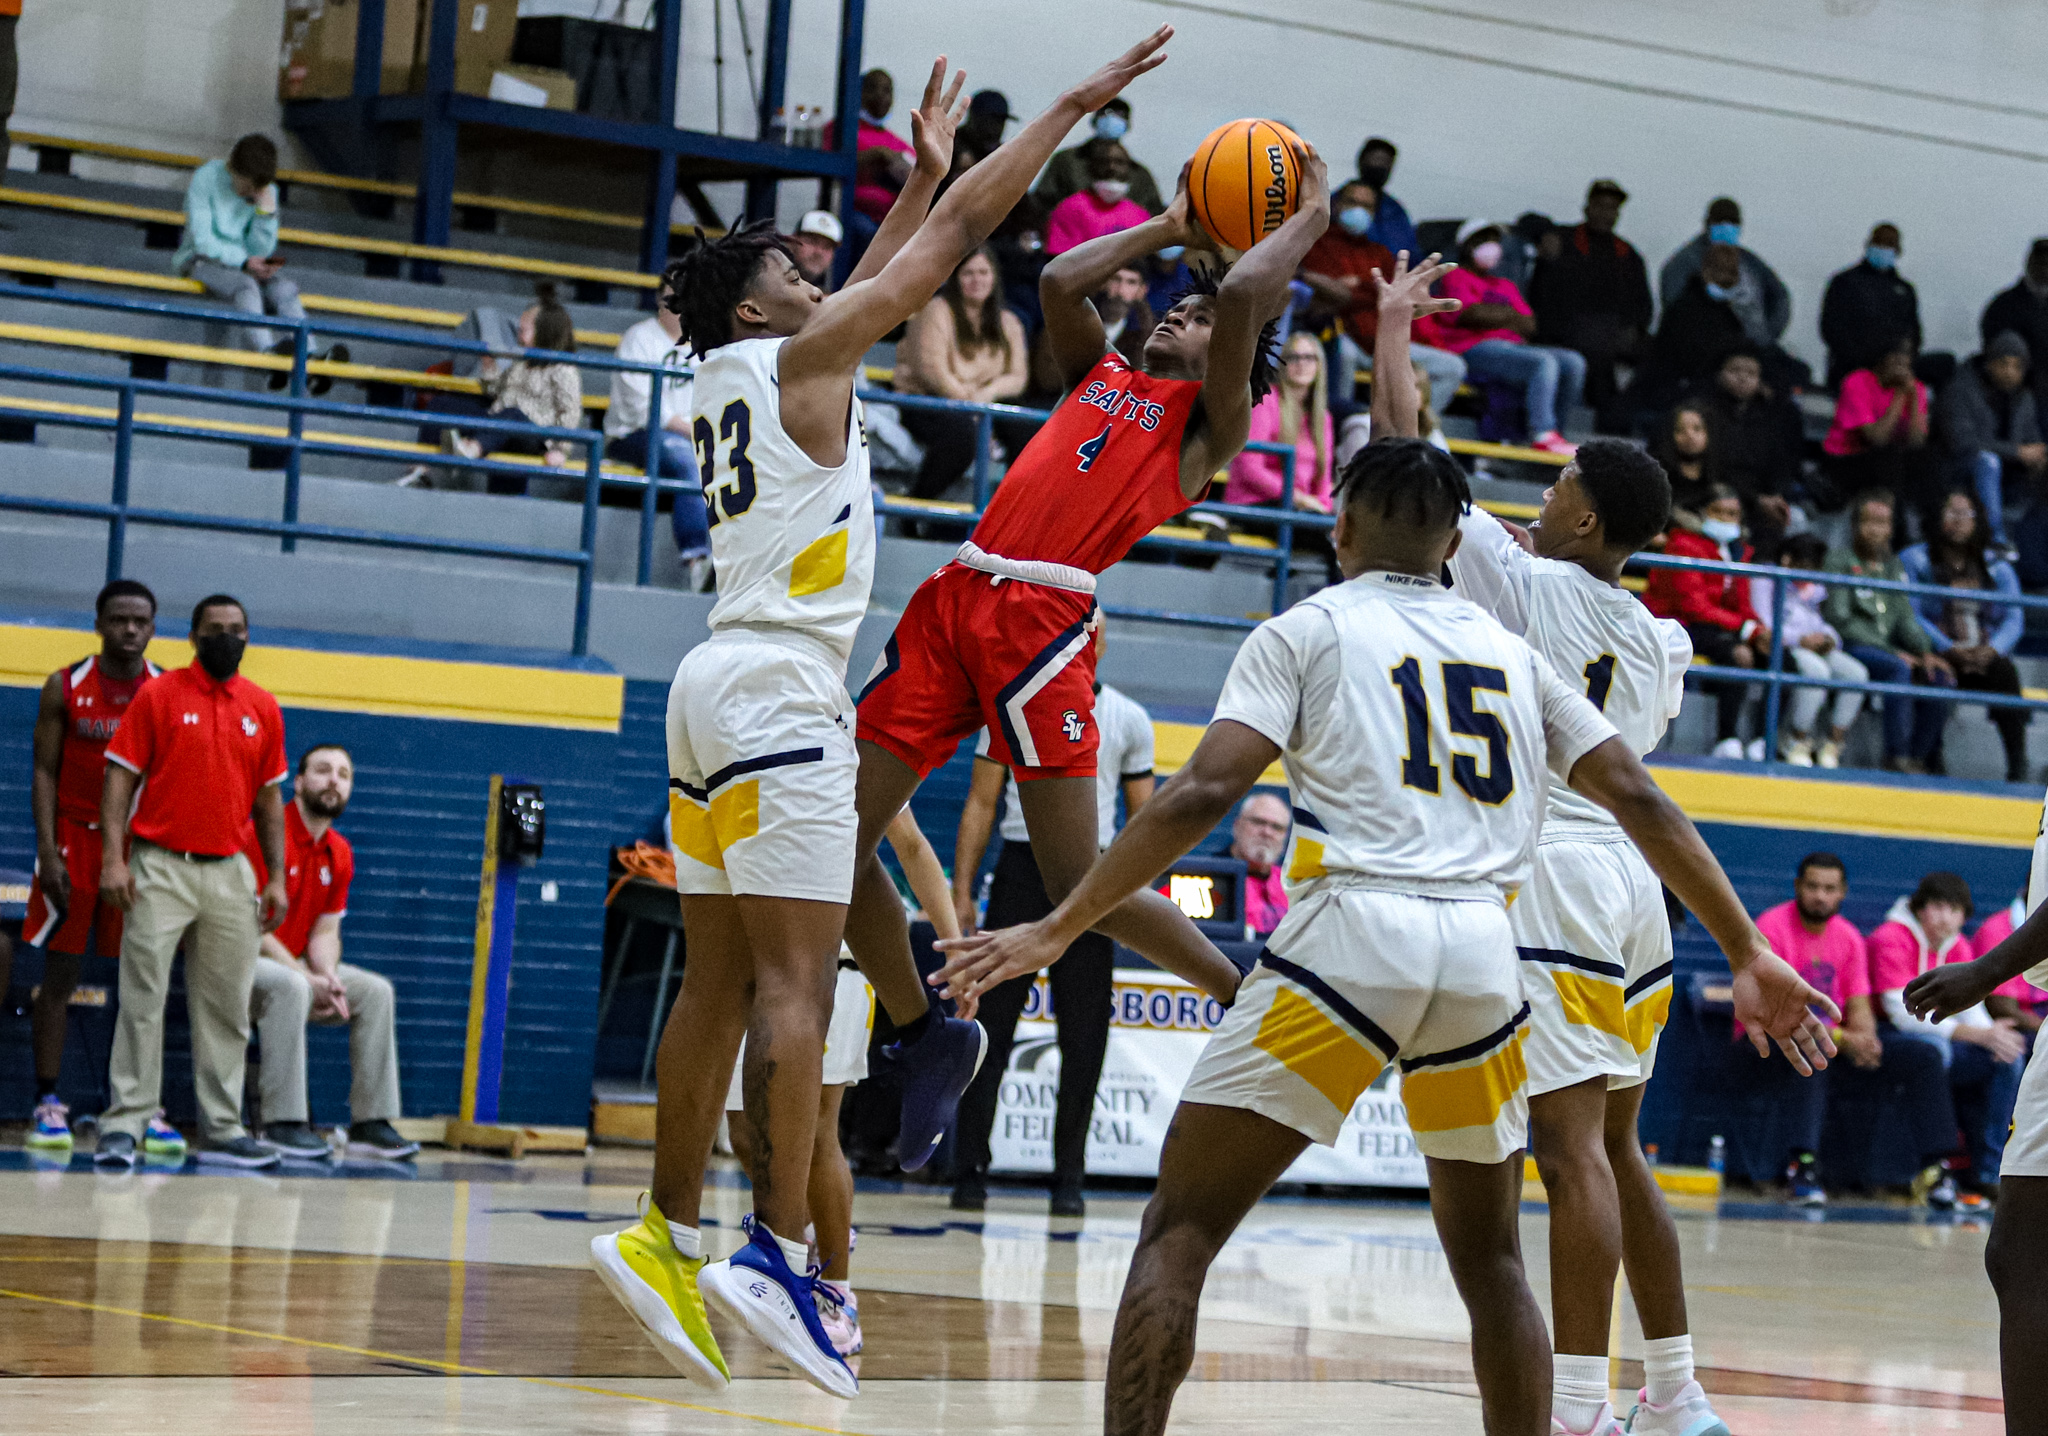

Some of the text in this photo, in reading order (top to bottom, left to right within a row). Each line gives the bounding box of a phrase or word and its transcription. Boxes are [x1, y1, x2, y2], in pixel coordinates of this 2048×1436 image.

[1262, 144, 1287, 233] Wilson
[693, 398, 758, 530] 23
[1076, 423, 1113, 473] 4
[1385, 573, 1412, 586] NIKE
[1583, 652, 1618, 714] 1
[1062, 712, 1086, 742] SW
[1388, 653, 1516, 808] 15
